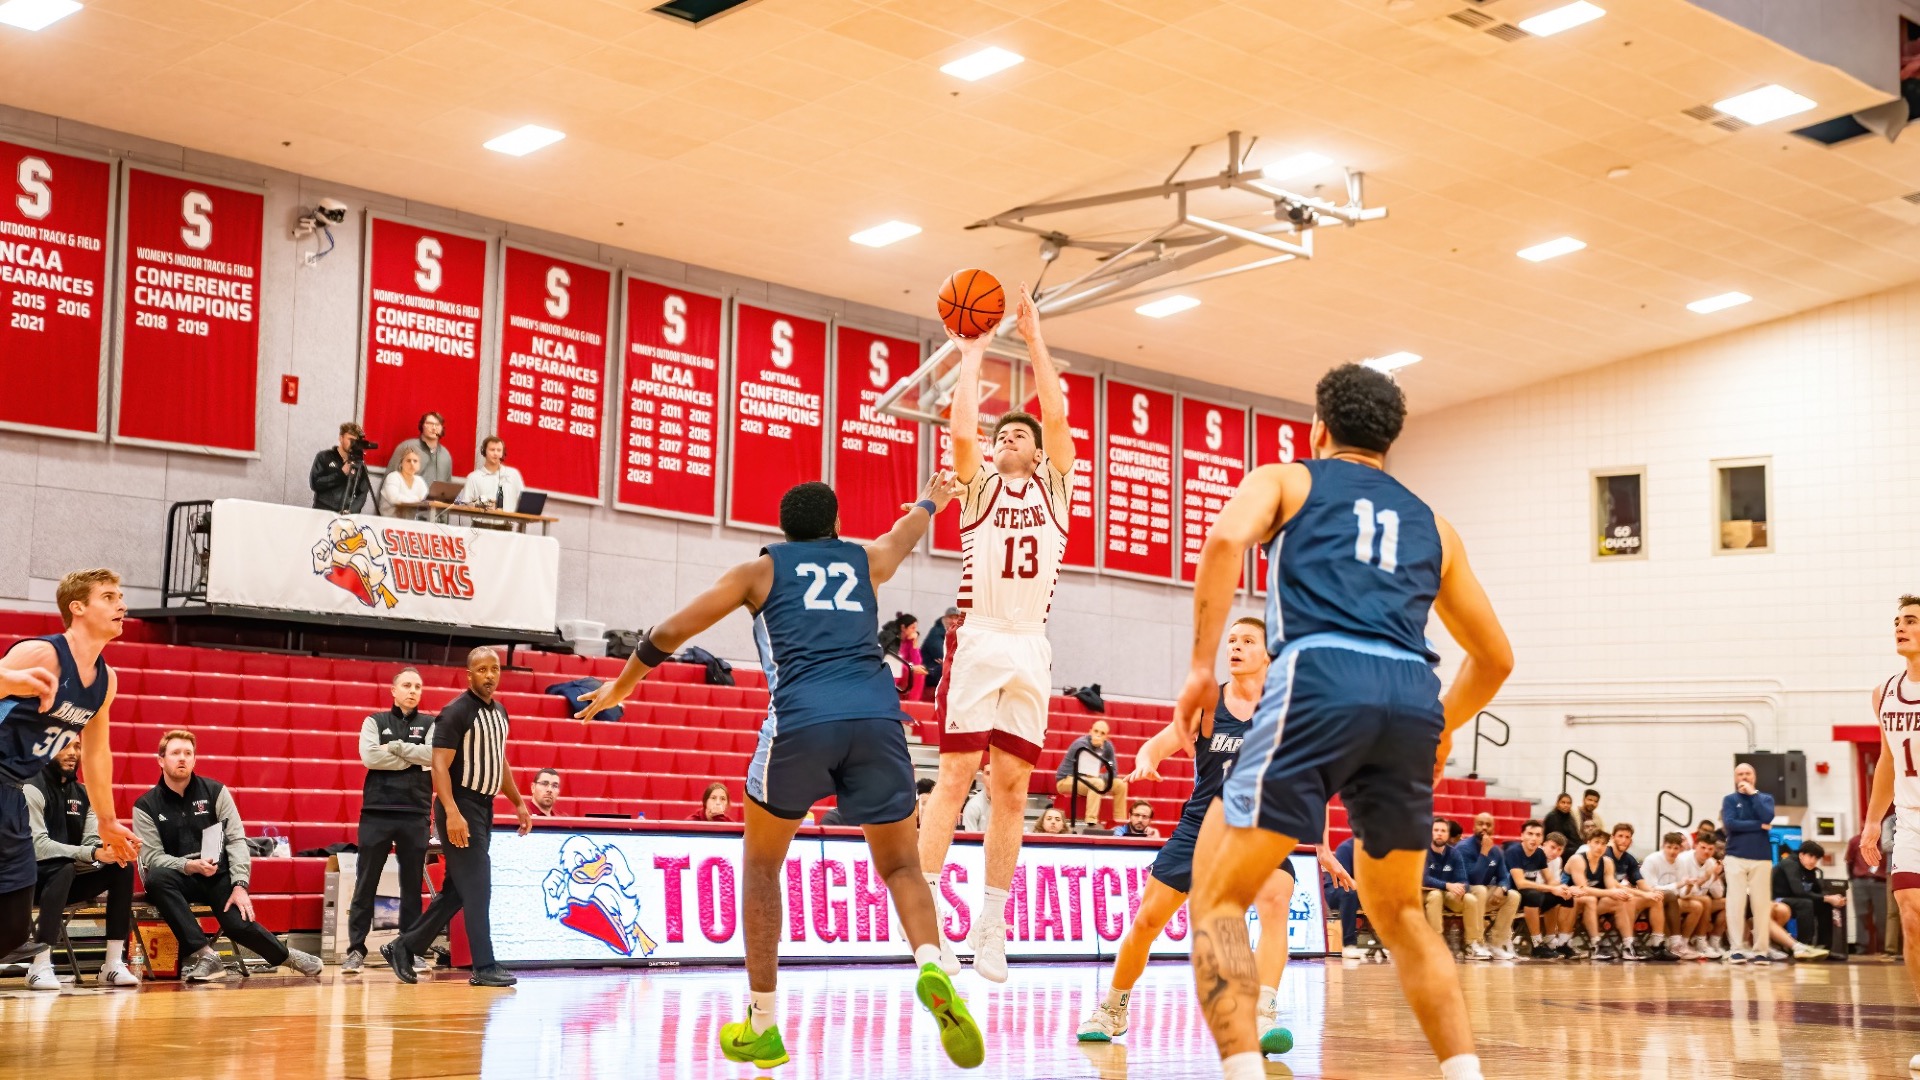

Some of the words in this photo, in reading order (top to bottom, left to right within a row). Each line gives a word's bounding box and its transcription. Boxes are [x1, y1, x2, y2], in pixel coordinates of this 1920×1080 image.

[16, 155, 53, 220] S
[180, 189, 213, 251] S
[0, 220, 37, 239] UTDOOR
[39, 228, 67, 246] TRACK
[68, 233, 76, 247] &
[77, 235, 101, 251] FIELD
[0, 240, 63, 273] NCAA
[136, 246, 173, 265] WOMEN'S
[174, 253, 203, 271] INDOOR
[204, 258, 226, 275] TRACK
[226, 263, 232, 275] &
[233, 263, 254, 279] FIELD
[414, 235, 443, 293] S
[0, 265, 94, 297] EARANCES
[135, 265, 253, 301] CONFERENCE
[544, 266, 572, 320] S
[12, 291, 46, 311] 2015
[57, 298, 91, 319] 2016
[134, 285, 253, 322] CHAMPIONS
[373, 288, 404, 305] WOMEN'S
[405, 295, 435, 311] OUTDOOR
[436, 300, 456, 315] TRACK
[455, 304, 462, 316] &
[462, 305, 480, 319] FIELD
[11, 312, 45, 332] 2021
[135, 311, 168, 330] 2018
[177, 318, 209, 337] 2019
[376, 306, 475, 340] CONFERENCE
[510, 314, 539, 331] WOMEN'S
[539, 321, 562, 337] INDOOR
[561, 326, 580, 341] TRACK
[585, 332, 602, 346] FIELD
[662, 294, 687, 346] S
[375, 325, 475, 359] CHAMPIONS
[531, 336, 577, 364] NCAA
[631, 342, 656, 358] WOMEN'S
[770, 319, 793, 370] S
[375, 349, 404, 367] 2019
[509, 352, 599, 384] APPEARANCES
[869, 340, 889, 388] S
[509, 372, 534, 390] 2013
[540, 378, 566, 396] 2014
[571, 385, 597, 402] 2015
[651, 362, 694, 388] NCAA
[760, 369, 801, 388] SOFTBALL
[508, 390, 533, 408] 2016
[540, 396, 565, 414] 2017
[570, 403, 596, 420] 2018
[630, 378, 713, 407] APPEARANCES
[740, 381, 821, 411] CONFERENCE
[506, 408, 532, 426] 2019
[538, 415, 564, 432] 2022
[569, 421, 596, 438] 2023
[631, 397, 654, 414] 2010
[661, 403, 682, 419] 2011
[689, 408, 711, 425] 2012
[739, 398, 821, 428] CHAMPIONS
[860, 403, 897, 427] NCAA
[1132, 393, 1149, 435] S
[630, 415, 653, 431] 2013
[659, 420, 683, 437] 2014
[688, 425, 711, 442] 2015
[740, 419, 763, 435] 2021
[767, 423, 792, 440] 2022
[842, 419, 915, 445] APPEARANCES
[1205, 409, 1223, 450] S
[1278, 423, 1295, 464] S
[629, 432, 652, 449] 2016
[658, 437, 682, 454] 2017
[687, 443, 710, 459] 2018
[842, 437, 863, 452] 2021
[867, 440, 889, 456] 2022
[1110, 447, 1170, 471] CONFERENCE
[627, 468, 651, 485] 2023
[628, 450, 651, 467] 2019
[657, 455, 681, 472] 2021
[686, 460, 711, 477] 2022
[1110, 461, 1170, 486] CHAMPIONS
[1198, 464, 1229, 485] NCAA
[381, 527, 467, 562] STEVENS
[1353, 498, 1400, 574] 11
[1605, 536, 1640, 549] DUCKS
[1614, 525, 1632, 538] GO
[1001, 535, 1039, 579] 13
[388, 558, 474, 600] DUCKS
[795, 562, 864, 612] 22
[1882, 711, 1920, 731] STEVE
[32, 726, 77, 760] 30
[653, 853, 971, 943] TOIGHS
[149, 937, 158, 960] S
